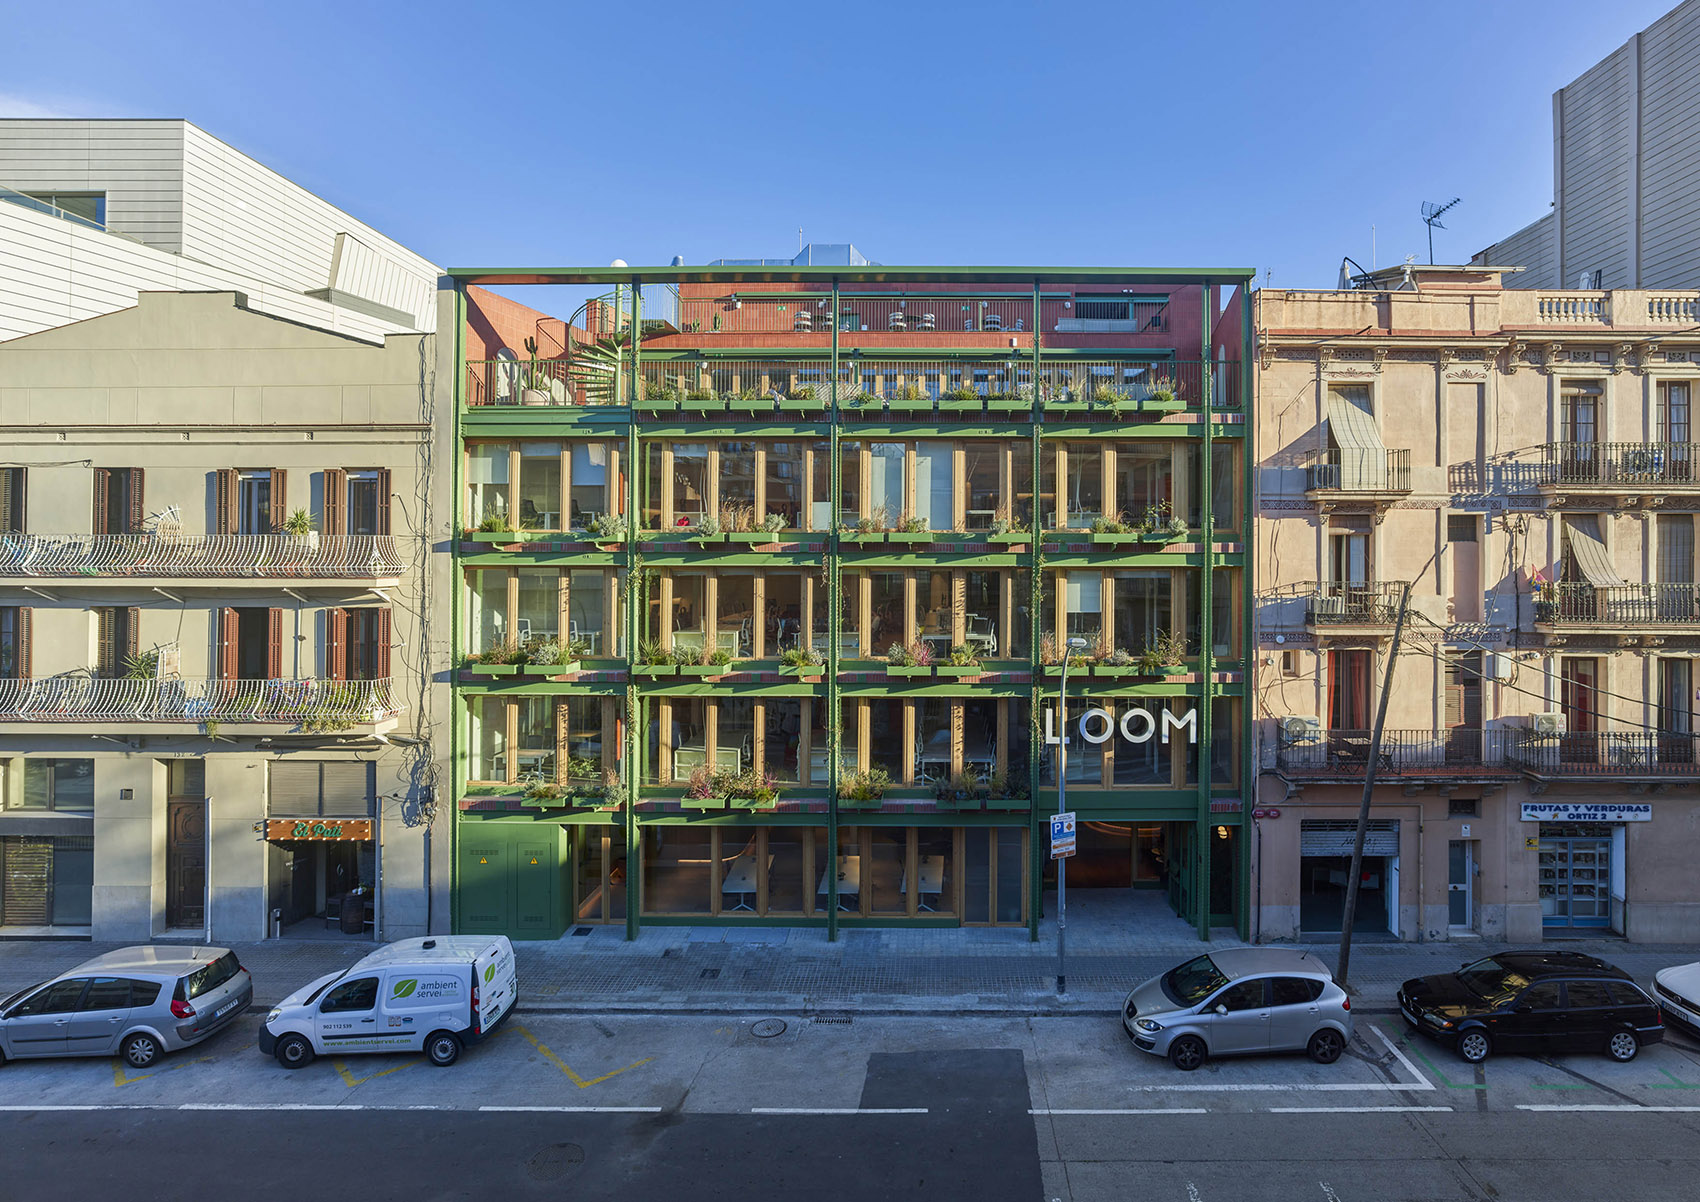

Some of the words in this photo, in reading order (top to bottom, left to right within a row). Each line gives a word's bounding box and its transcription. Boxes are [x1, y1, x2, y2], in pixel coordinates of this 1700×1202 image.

[1045, 707, 1197, 744] LOOM
[1523, 804, 1570, 812] FRUTAS
[1572, 804, 1581, 812] Y
[1584, 804, 1650, 813] VERDURAS
[292, 822, 309, 838] El
[311, 823, 343, 838] Pati
[1054, 823, 1062, 834] P
[420, 980, 457, 990] ambient
[416, 989, 442, 998] servei
[323, 1038, 411, 1047] www.ambientservei.com
